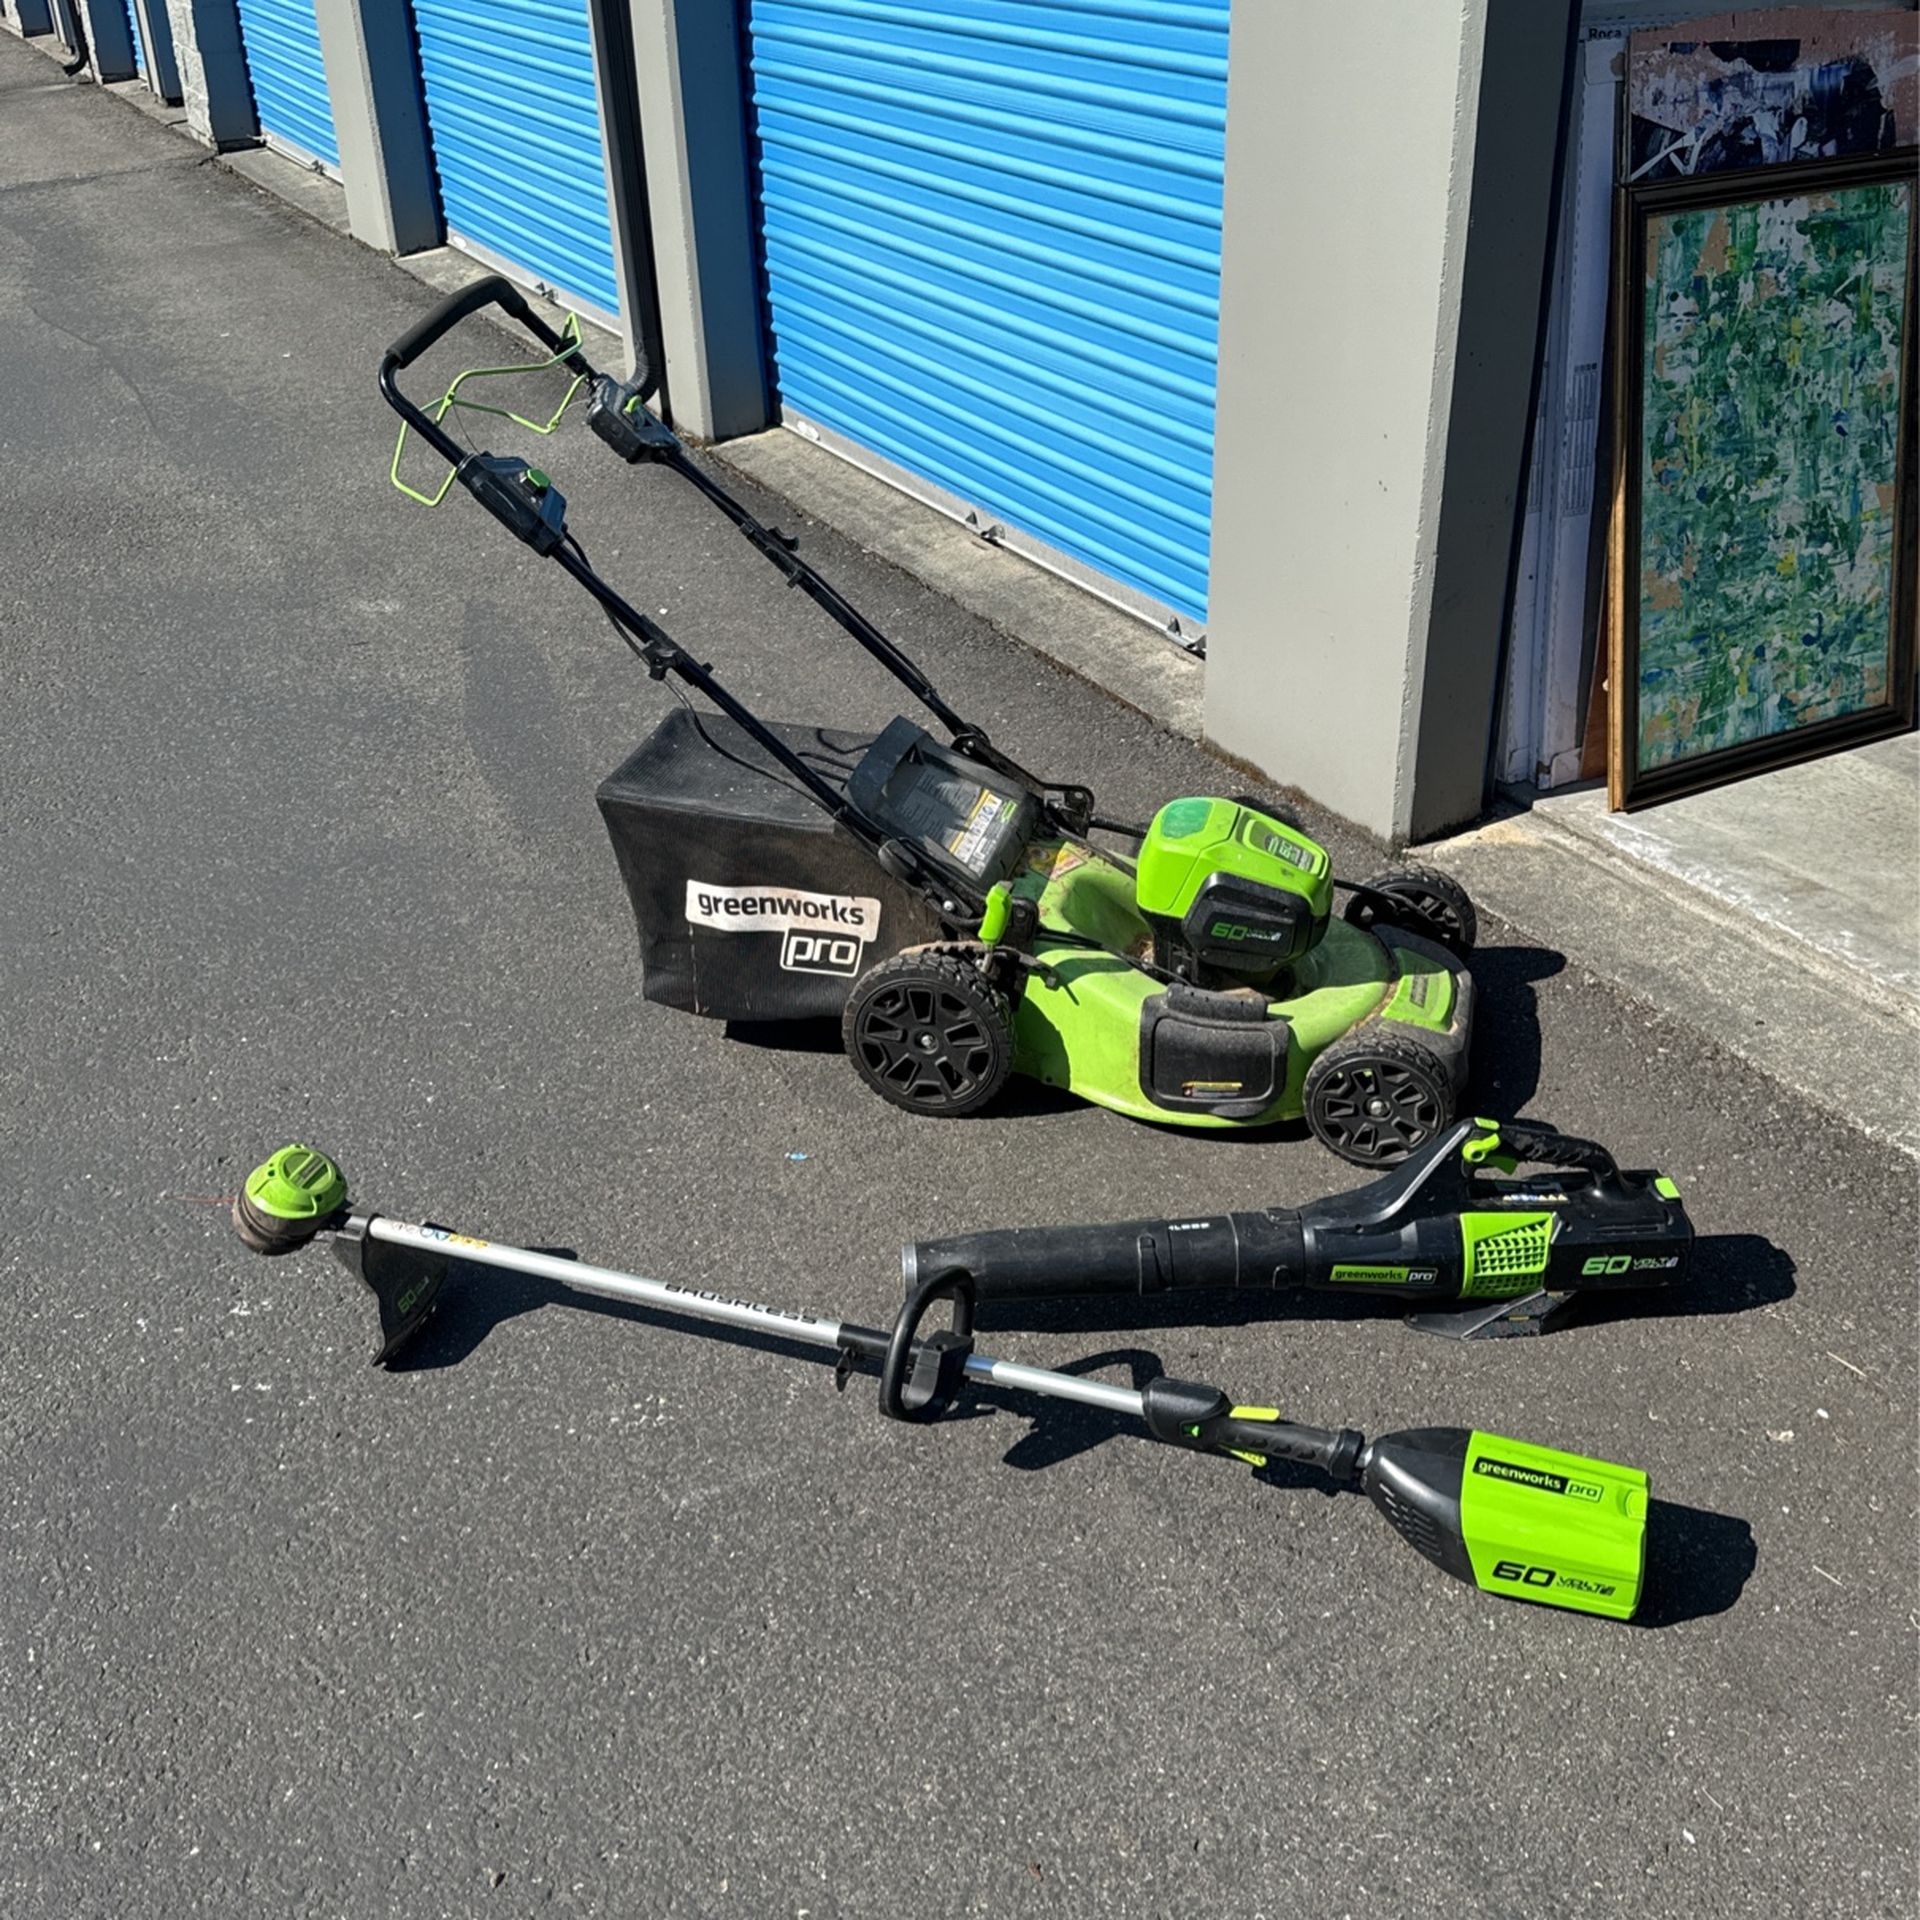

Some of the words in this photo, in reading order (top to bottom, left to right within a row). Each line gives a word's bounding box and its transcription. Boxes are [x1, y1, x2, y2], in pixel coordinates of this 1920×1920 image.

[698, 893, 865, 926] greenworks
[1211, 922, 1249, 940] 60
[786, 936, 858, 967] pro
[1335, 1270, 1403, 1281] greenworks
[1408, 1272, 1433, 1282] pro
[1582, 1255, 1632, 1275] 60
[1478, 1460, 1562, 1490] greenworks
[1568, 1481, 1598, 1498] pro
[1492, 1559, 1557, 1588] 60
